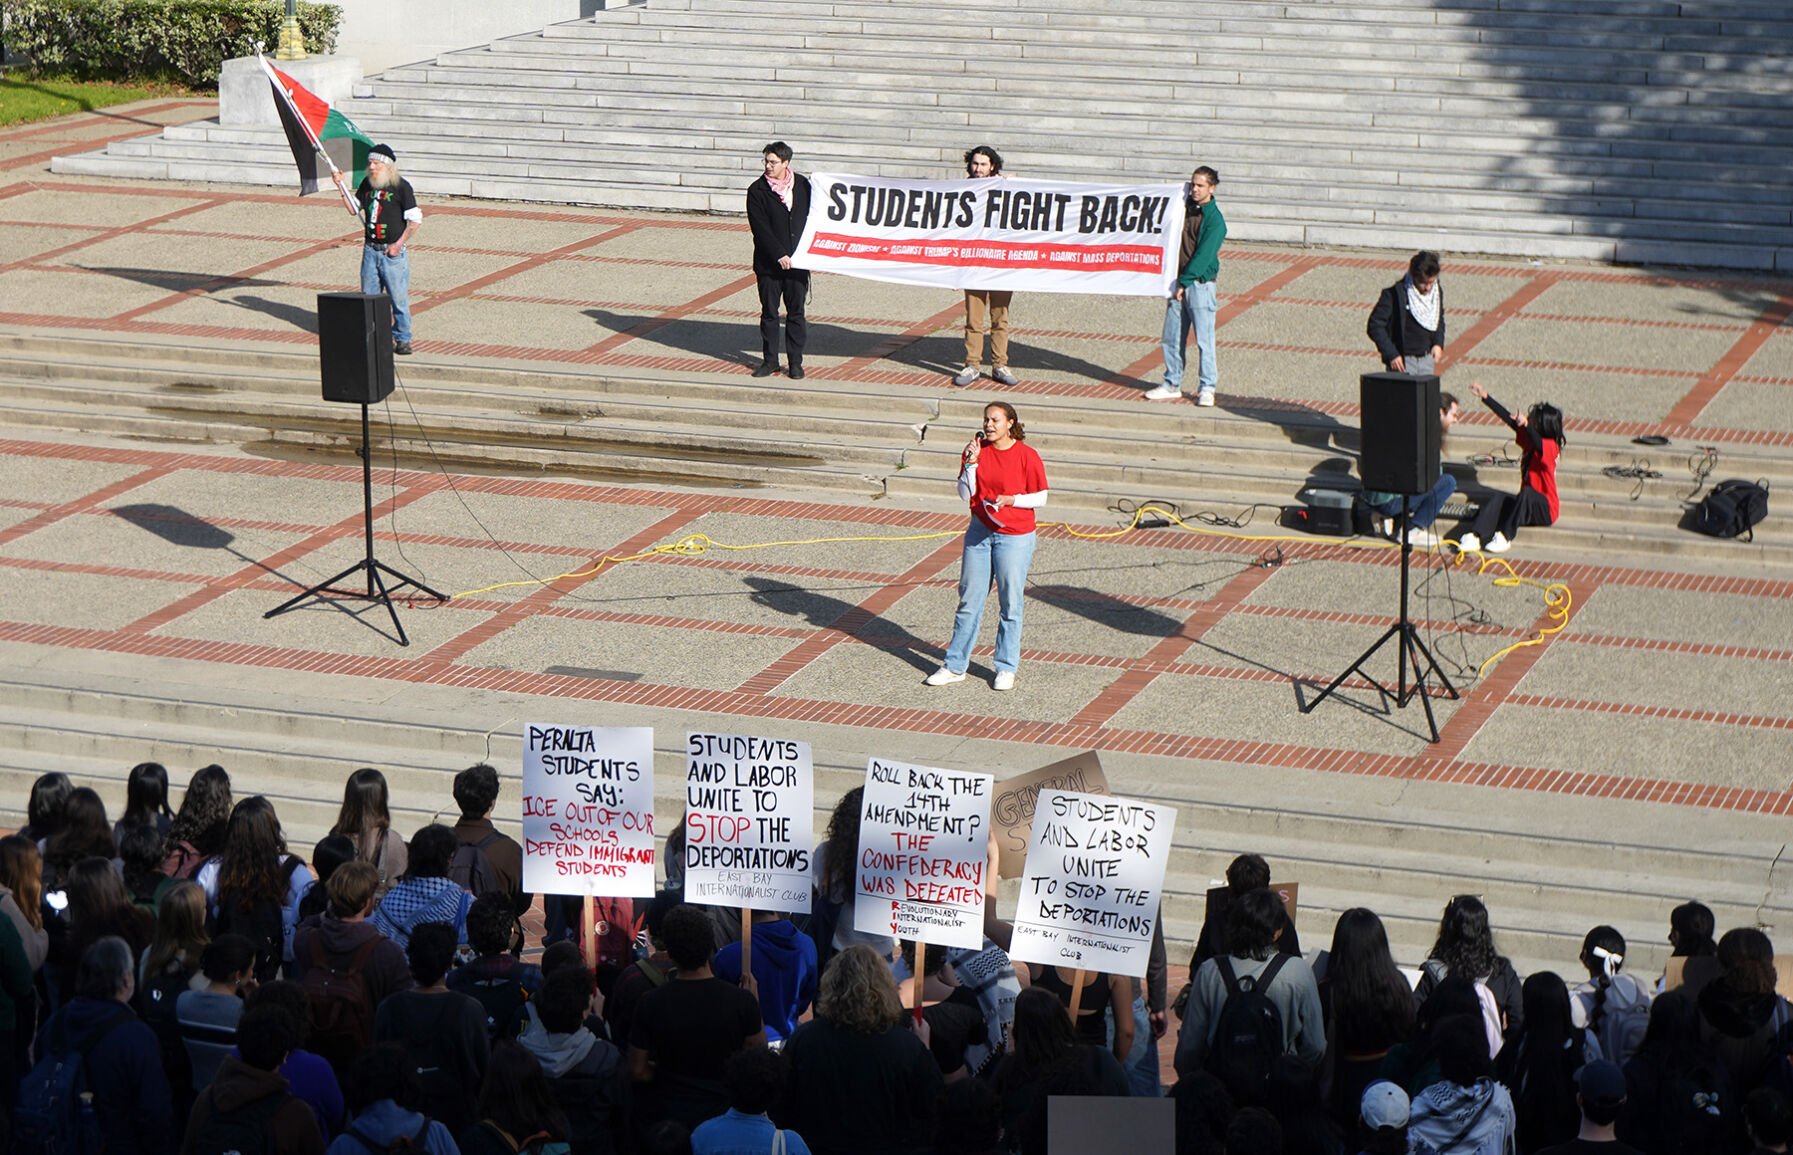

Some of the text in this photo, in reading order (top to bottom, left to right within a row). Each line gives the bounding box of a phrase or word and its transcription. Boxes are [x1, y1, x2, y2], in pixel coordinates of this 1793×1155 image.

[827, 182, 1170, 234] STUDENTS FIGHT BACK!
[813, 239, 847, 251] AGAINST
[889, 245, 922, 256] AGAINST
[924, 246, 959, 258] TRUMP'S
[960, 248, 1006, 261] BILLIONAIRE
[1008, 250, 1038, 261] AGENDA
[1050, 251, 1081, 263] AGAINST
[1082, 252, 1105, 264] MASS
[1105, 252, 1160, 266] DEPORTATIONS
[529, 726, 596, 752] PERALTA
[689, 734, 798, 761] STUDENTS
[541, 754, 640, 781] STUDENTS
[687, 760, 797, 787] AND LABOR
[871, 761, 986, 796] ROLL BACK THE
[575, 782, 624, 807] SAY:
[687, 786, 778, 812] UNITE TO
[904, 792, 951, 811] 14TH
[993, 767, 1104, 828] GENRAL
[522, 796, 654, 835] ICE OUT OF OUR
[864, 803, 981, 842] AMENDMENT?
[1051, 795, 1156, 832] STUDENTS
[549, 822, 619, 847] SCHOOLS
[687, 812, 791, 844] STOP THE
[890, 832, 935, 851] THE
[1040, 822, 1079, 848] AND
[1086, 828, 1150, 858] LABOR
[525, 838, 655, 864] DEFEND IMMIGRANT
[686, 845, 809, 872] DEPORTATIONS
[555, 860, 628, 877] STUDENTS
[717, 871, 773, 885] EAST BAY
[861, 848, 982, 885] CONFEDERACY
[1062, 855, 1122, 879] UNITE
[695, 882, 808, 902] INTERNATIONALIST CLUB
[862, 875, 983, 906] WAS DEFEATED
[1030, 876, 1150, 907] TO STOP THE
[891, 901, 958, 918] REVOLUTIONARY
[892, 911, 965, 927] INTERNATIONALIST
[1039, 900, 1151, 937] DEPORTATIONS
[890, 922, 920, 935] YOUTH
[1017, 926, 1041, 937] EAST
[1042, 930, 1059, 942] BAY
[1060, 948, 1082, 960] CLUB
